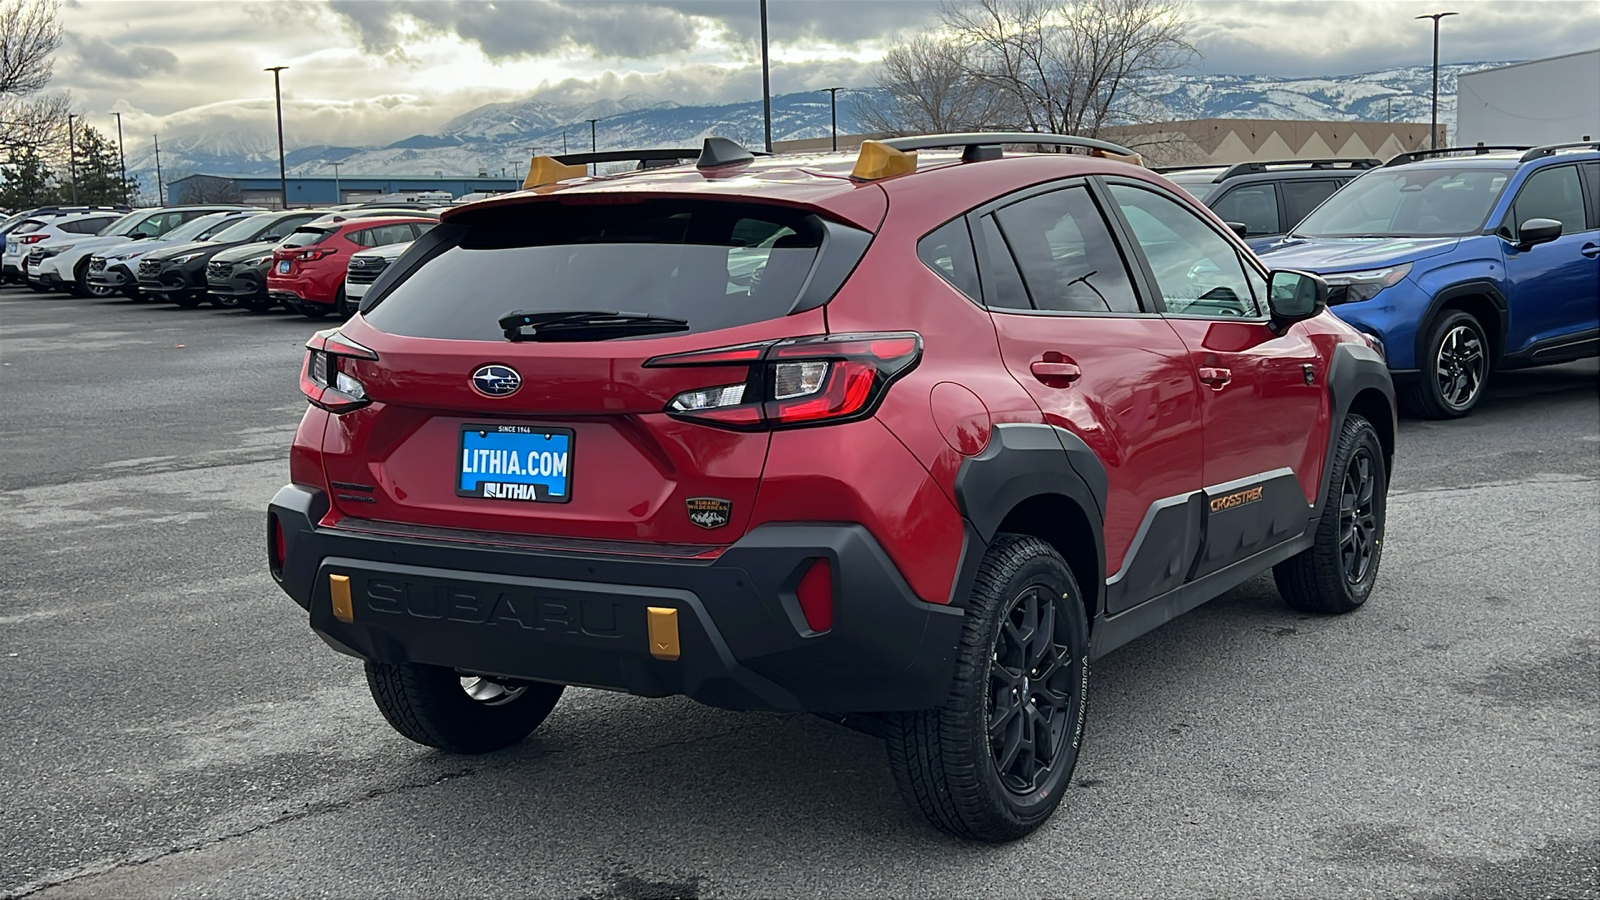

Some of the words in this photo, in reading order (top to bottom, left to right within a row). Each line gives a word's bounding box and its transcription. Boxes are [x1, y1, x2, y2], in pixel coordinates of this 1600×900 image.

[498, 425, 516, 433] SINCE
[462, 448, 568, 478] LITHIA.COM
[495, 483, 537, 500] LITHIA
[1210, 486, 1263, 512] CROSSTREK
[366, 578, 624, 639] SUBARU
